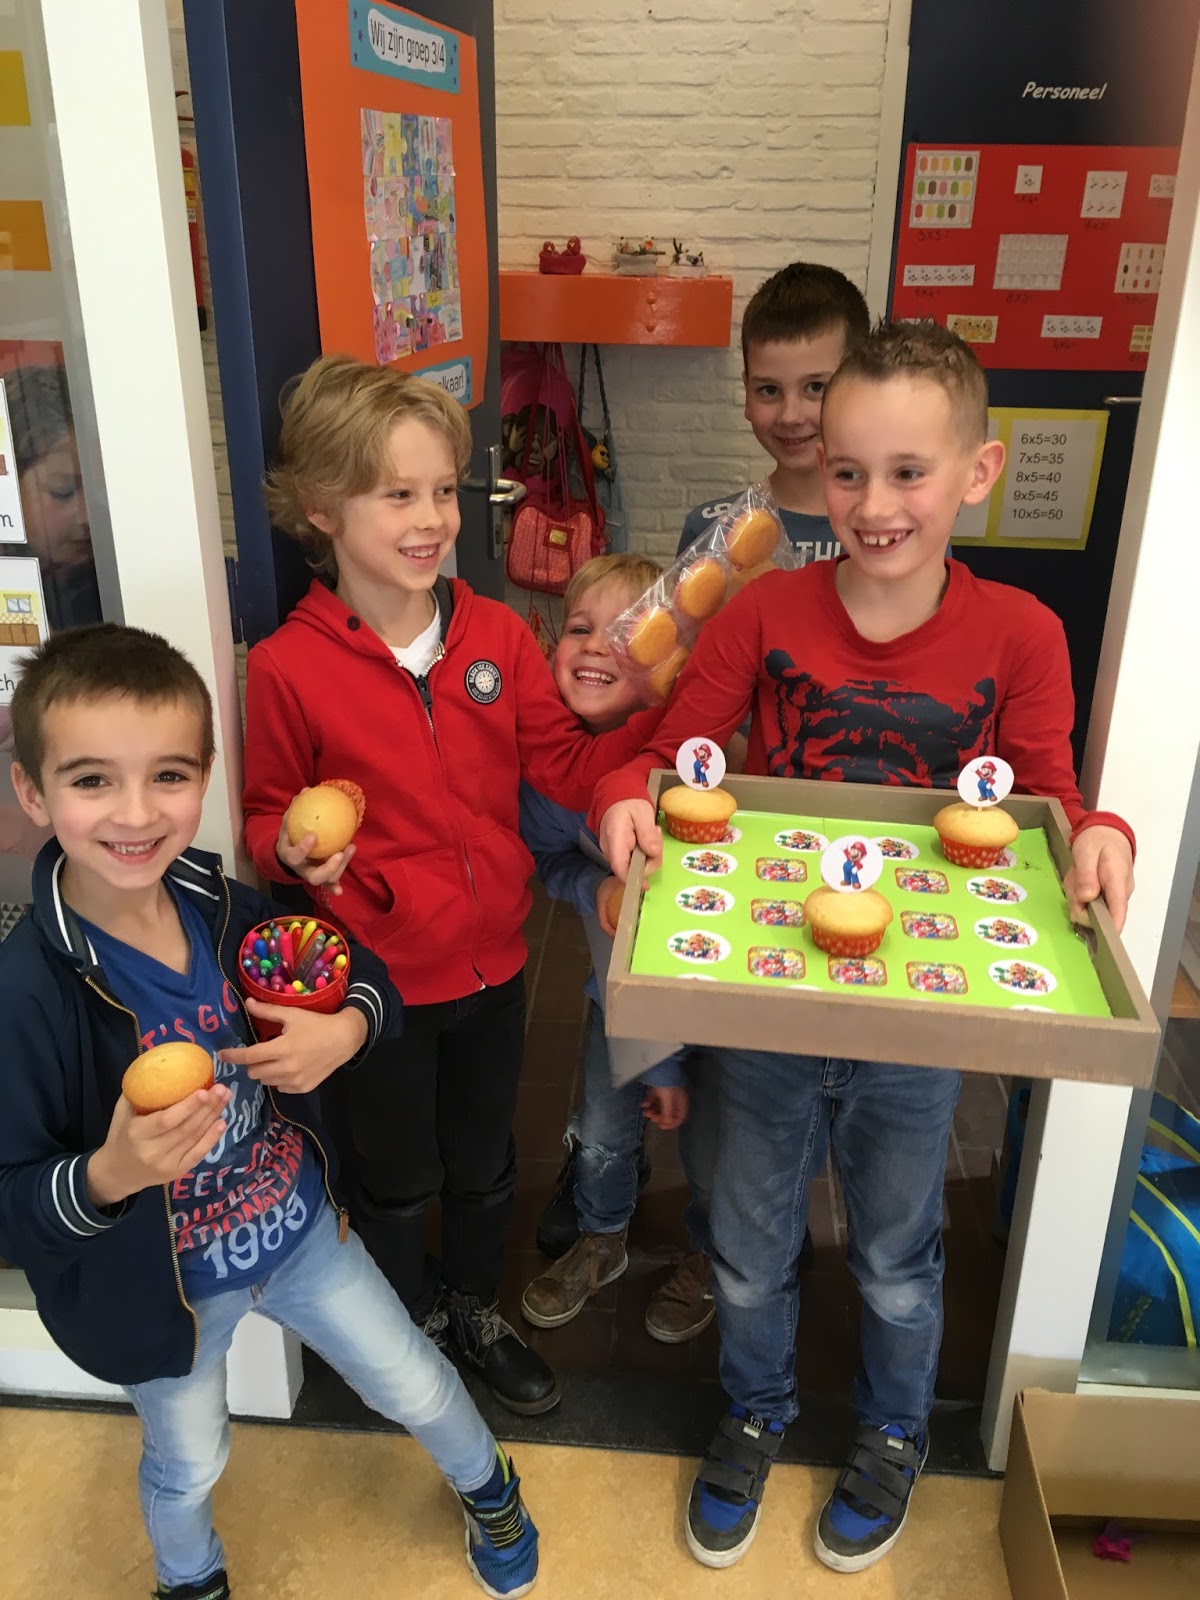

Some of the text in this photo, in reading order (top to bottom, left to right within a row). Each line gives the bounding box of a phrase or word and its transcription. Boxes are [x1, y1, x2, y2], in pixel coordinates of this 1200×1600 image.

[370, 19, 445, 67] Wij zijn groep 3/4
[1021, 81, 1108, 100] Personeel
[1021, 433, 1067, 446] 6x5=30
[1019, 452, 1065, 465] 7x5=35
[1015, 471, 1062, 483] 8x5=40
[1013, 490, 1059, 502] 9x5=45
[1012, 508, 1064, 521] 10x5=50
